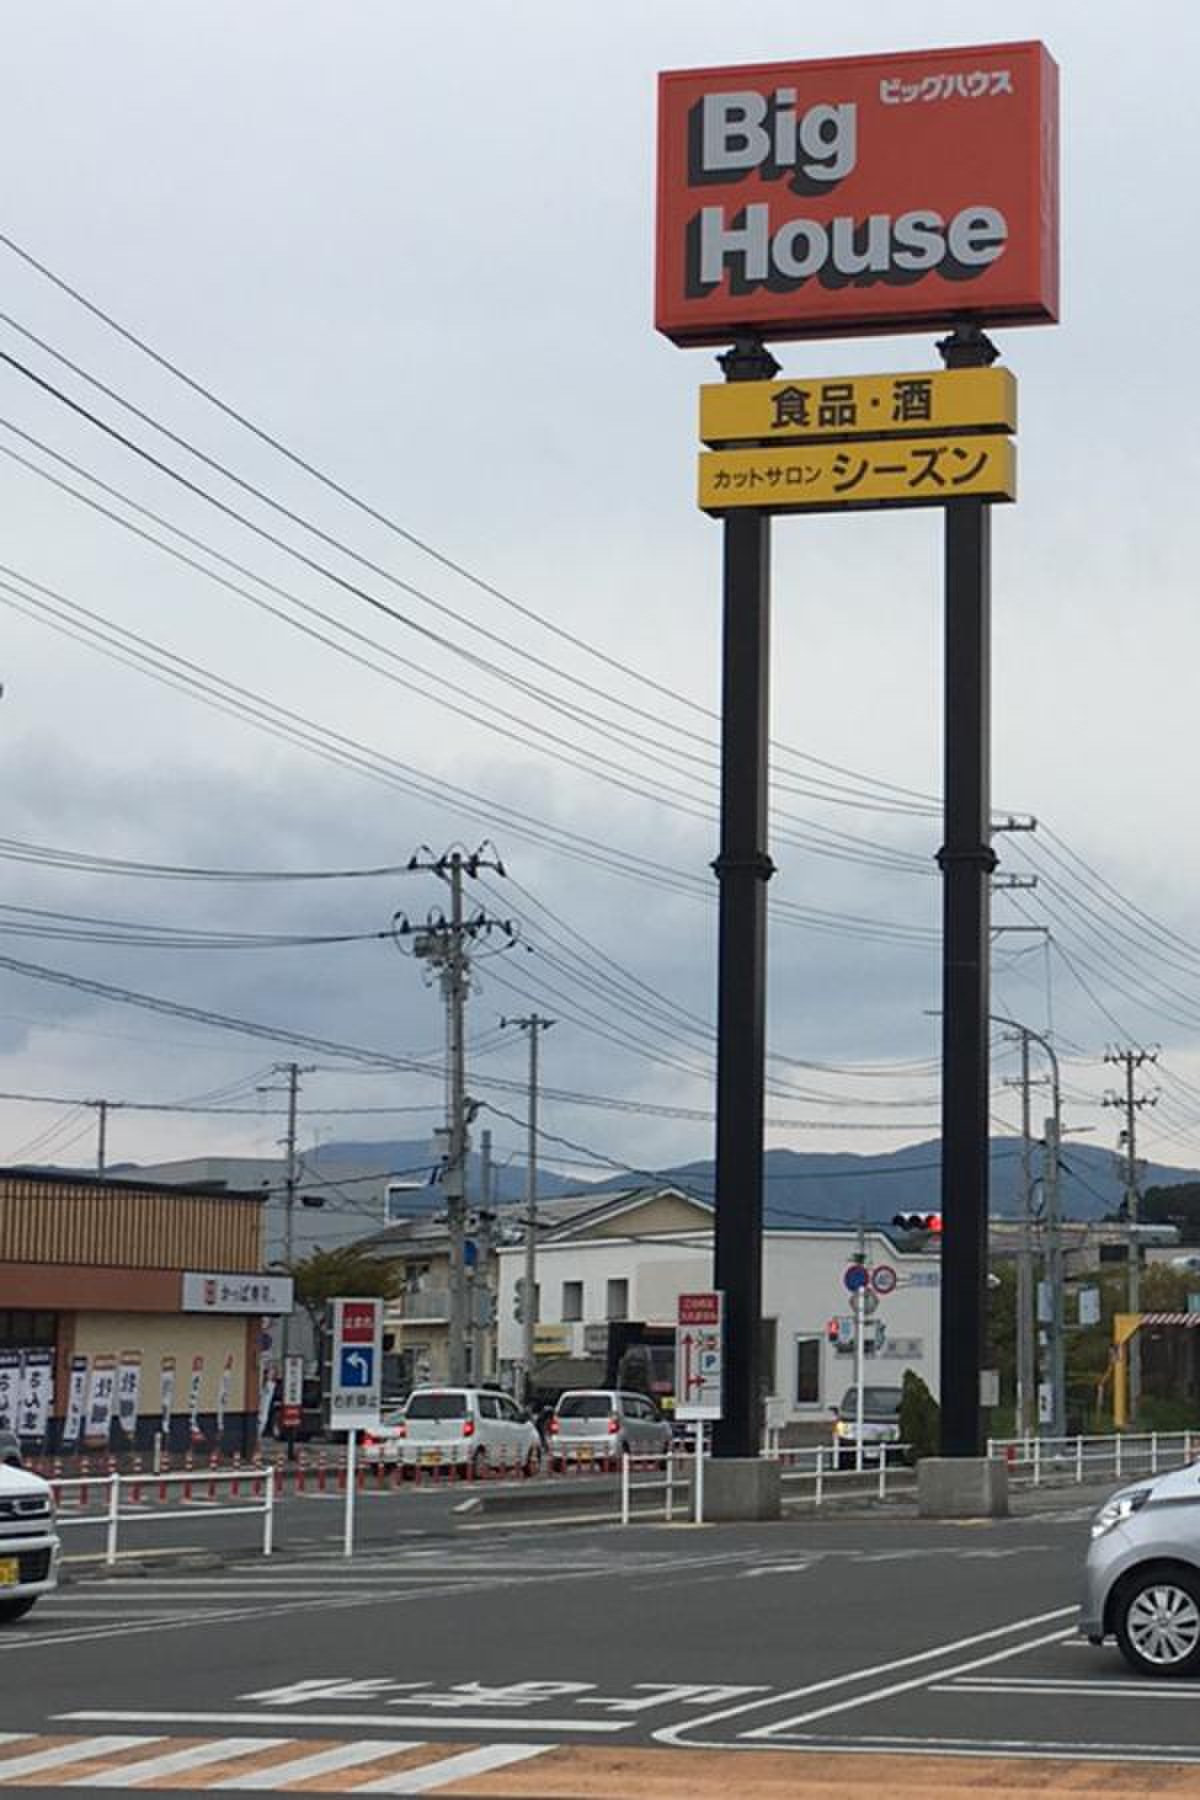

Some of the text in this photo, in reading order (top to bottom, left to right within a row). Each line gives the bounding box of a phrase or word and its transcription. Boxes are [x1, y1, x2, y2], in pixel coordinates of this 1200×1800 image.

[693, 86, 858, 188] Big
[691, 203, 1008, 290] House
[770, 378, 933, 429] 食品・酒
[831, 446, 989, 492] シーズン
